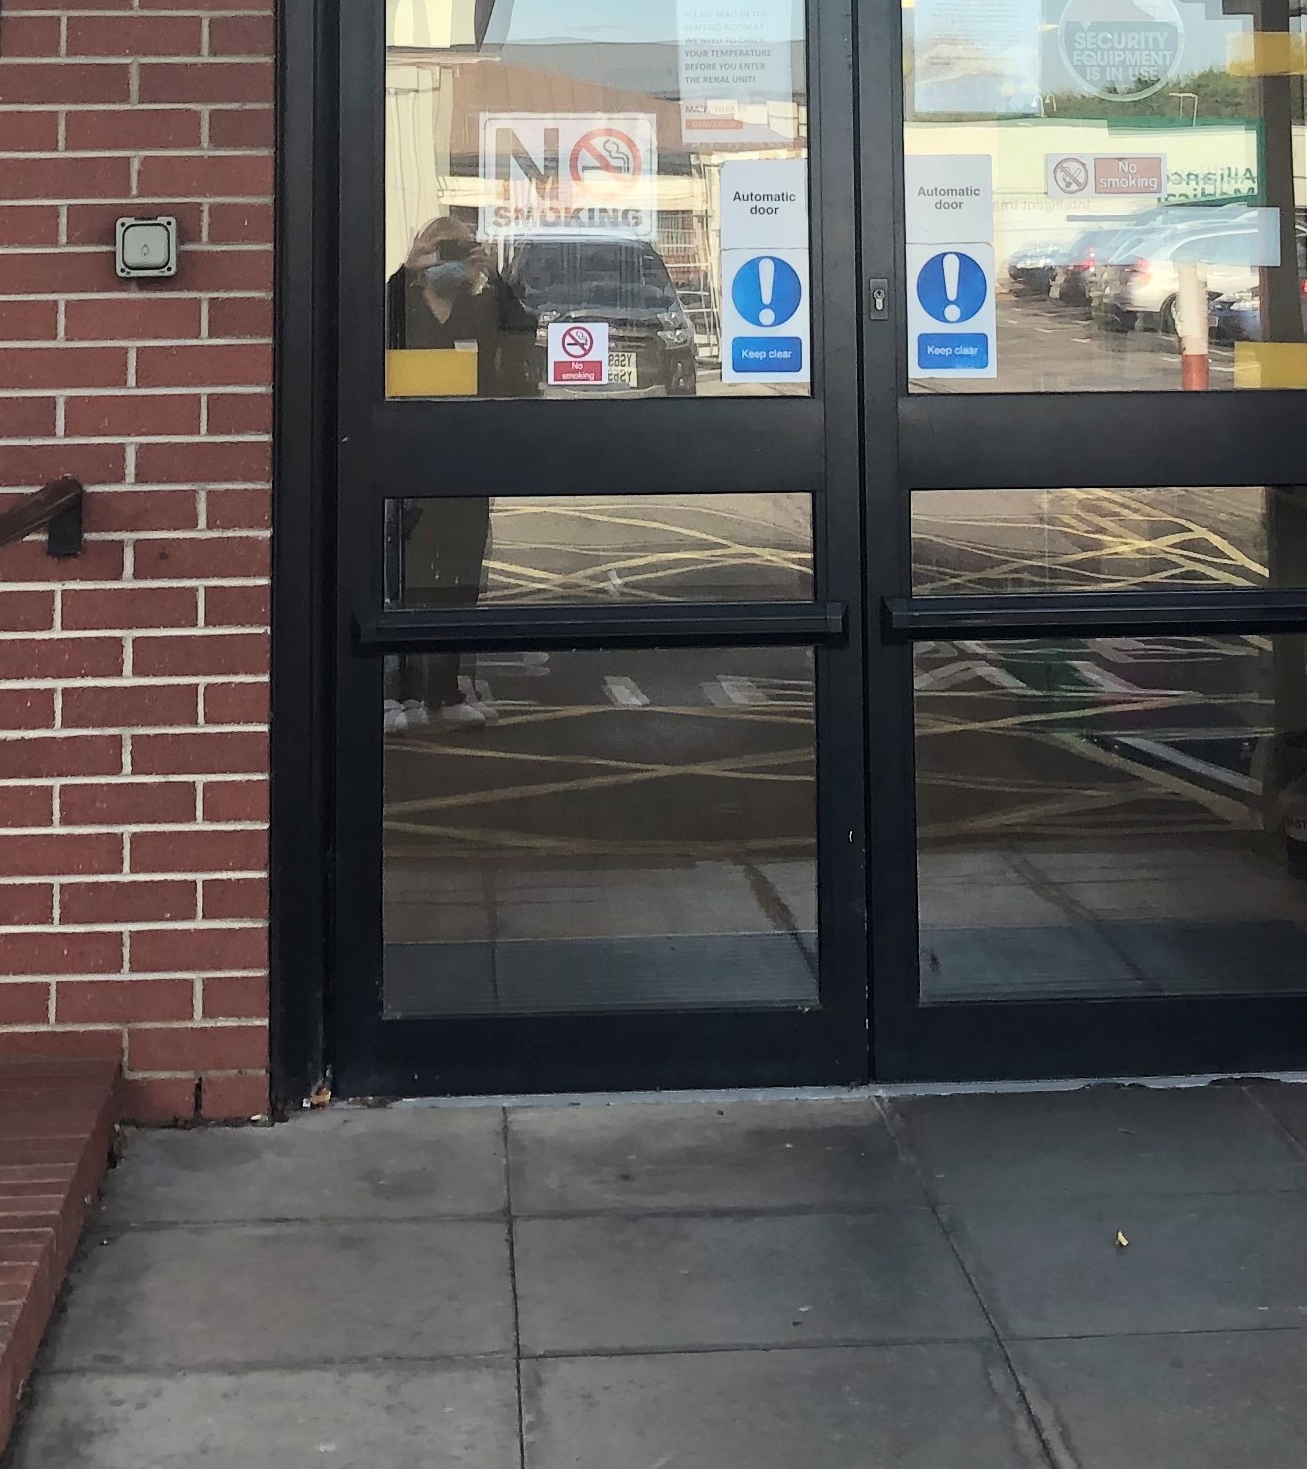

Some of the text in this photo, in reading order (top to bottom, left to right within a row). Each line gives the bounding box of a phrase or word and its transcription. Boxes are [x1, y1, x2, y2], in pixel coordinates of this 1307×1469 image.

[1074, 31, 1169, 50] SECURITY
[684, 49, 772, 58] YOUR TEMPERATURE
[1072, 50, 1172, 66] EQUIPMENT
[684, 62, 766, 71] BEFORE YOU ENTER
[1086, 66, 1159, 81] IS IN USE
[685, 76, 701, 84] THE
[703, 76, 730, 84] RENAL
[1118, 161, 1138, 174] No
[1099, 175, 1158, 191] smoking
[733, 191, 796, 202] Automatic
[917, 186, 981, 197] Automatic
[749, 205, 779, 215] door
[934, 199, 964, 210] door
[493, 206, 643, 227] SMOKING
[741, 349, 793, 360] Keep clear
[927, 345, 979, 357] Keep clear
[571, 361, 584, 370] No
[561, 371, 595, 381] smoking
